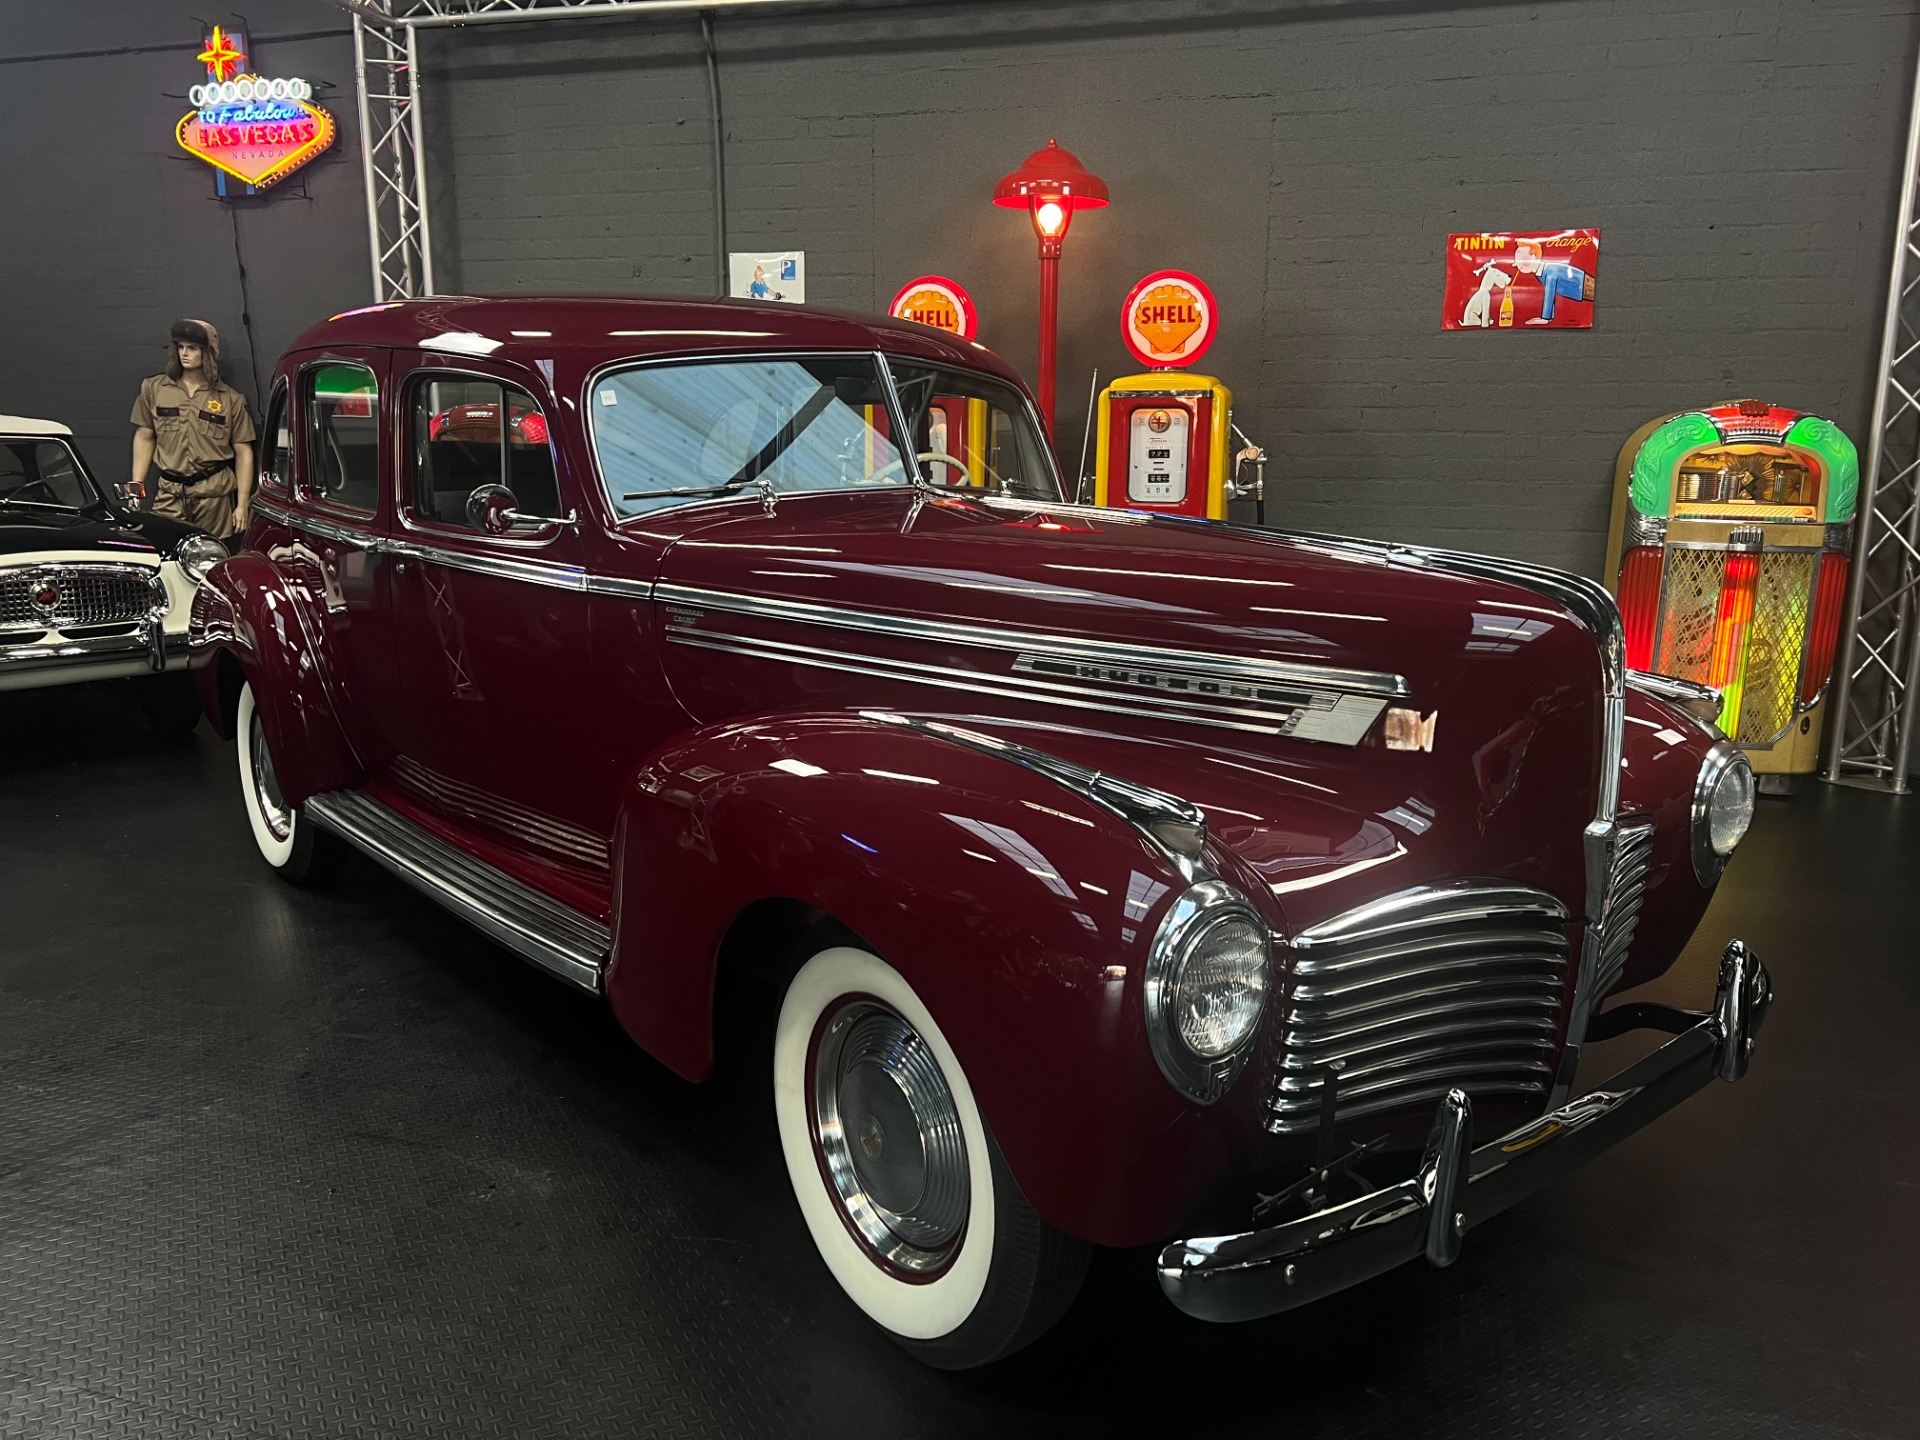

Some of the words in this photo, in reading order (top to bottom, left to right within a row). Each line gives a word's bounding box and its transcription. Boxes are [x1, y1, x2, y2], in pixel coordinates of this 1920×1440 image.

[196, 126, 233, 147] LAS
[238, 122, 309, 145] VEGAS
[232, 149, 285, 160] NEVADA
[1455, 237, 1505, 250] TINTIN
[904, 310, 953, 327] HELL
[1141, 304, 1196, 325] SHELL
